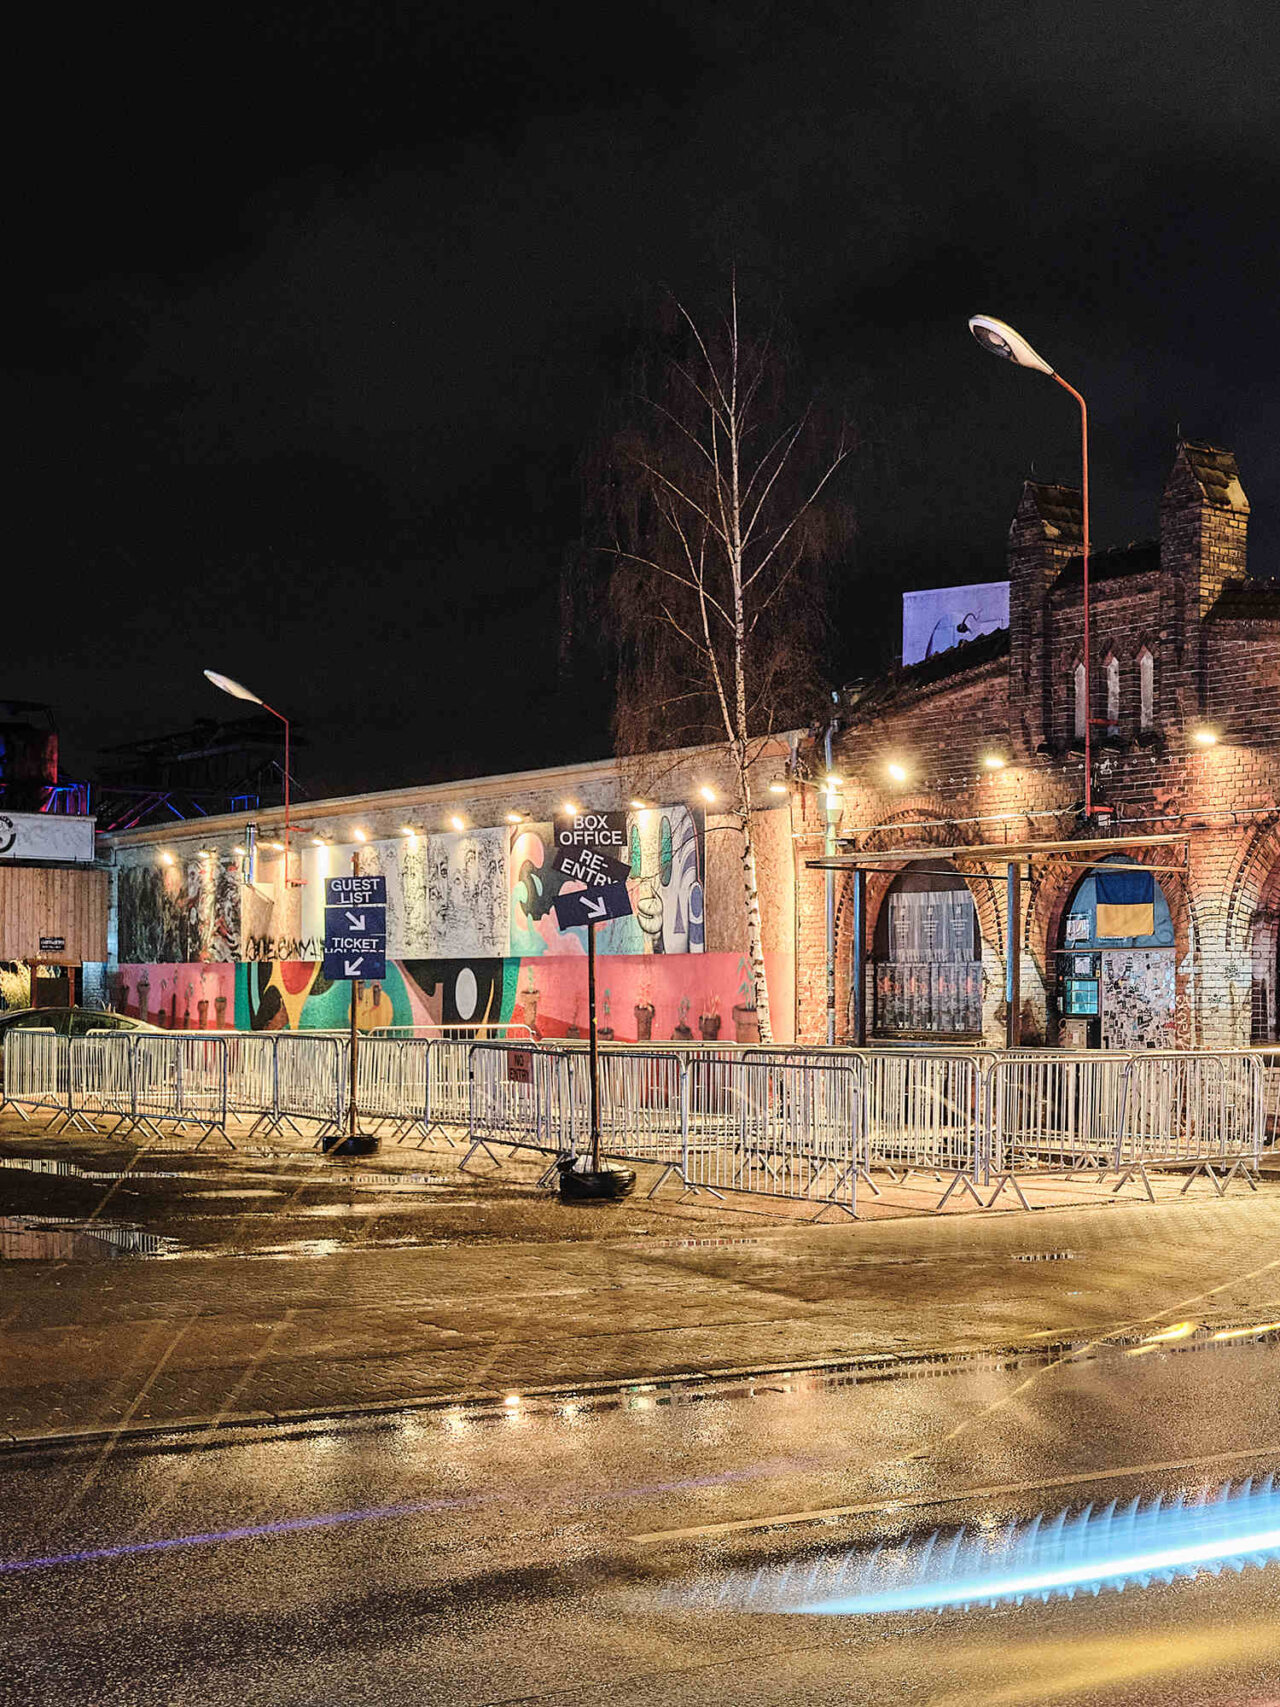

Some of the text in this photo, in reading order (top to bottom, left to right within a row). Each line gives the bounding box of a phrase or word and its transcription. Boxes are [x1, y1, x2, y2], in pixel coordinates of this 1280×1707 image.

[574, 815, 609, 829] BOX
[560, 831, 623, 845] OFFICE
[579, 849, 609, 870] RE-
[331, 879, 380, 891] GUEST
[340, 891, 372, 904] LIST
[332, 937, 379, 949] TICKET
[514, 1054, 525, 1067] NO
